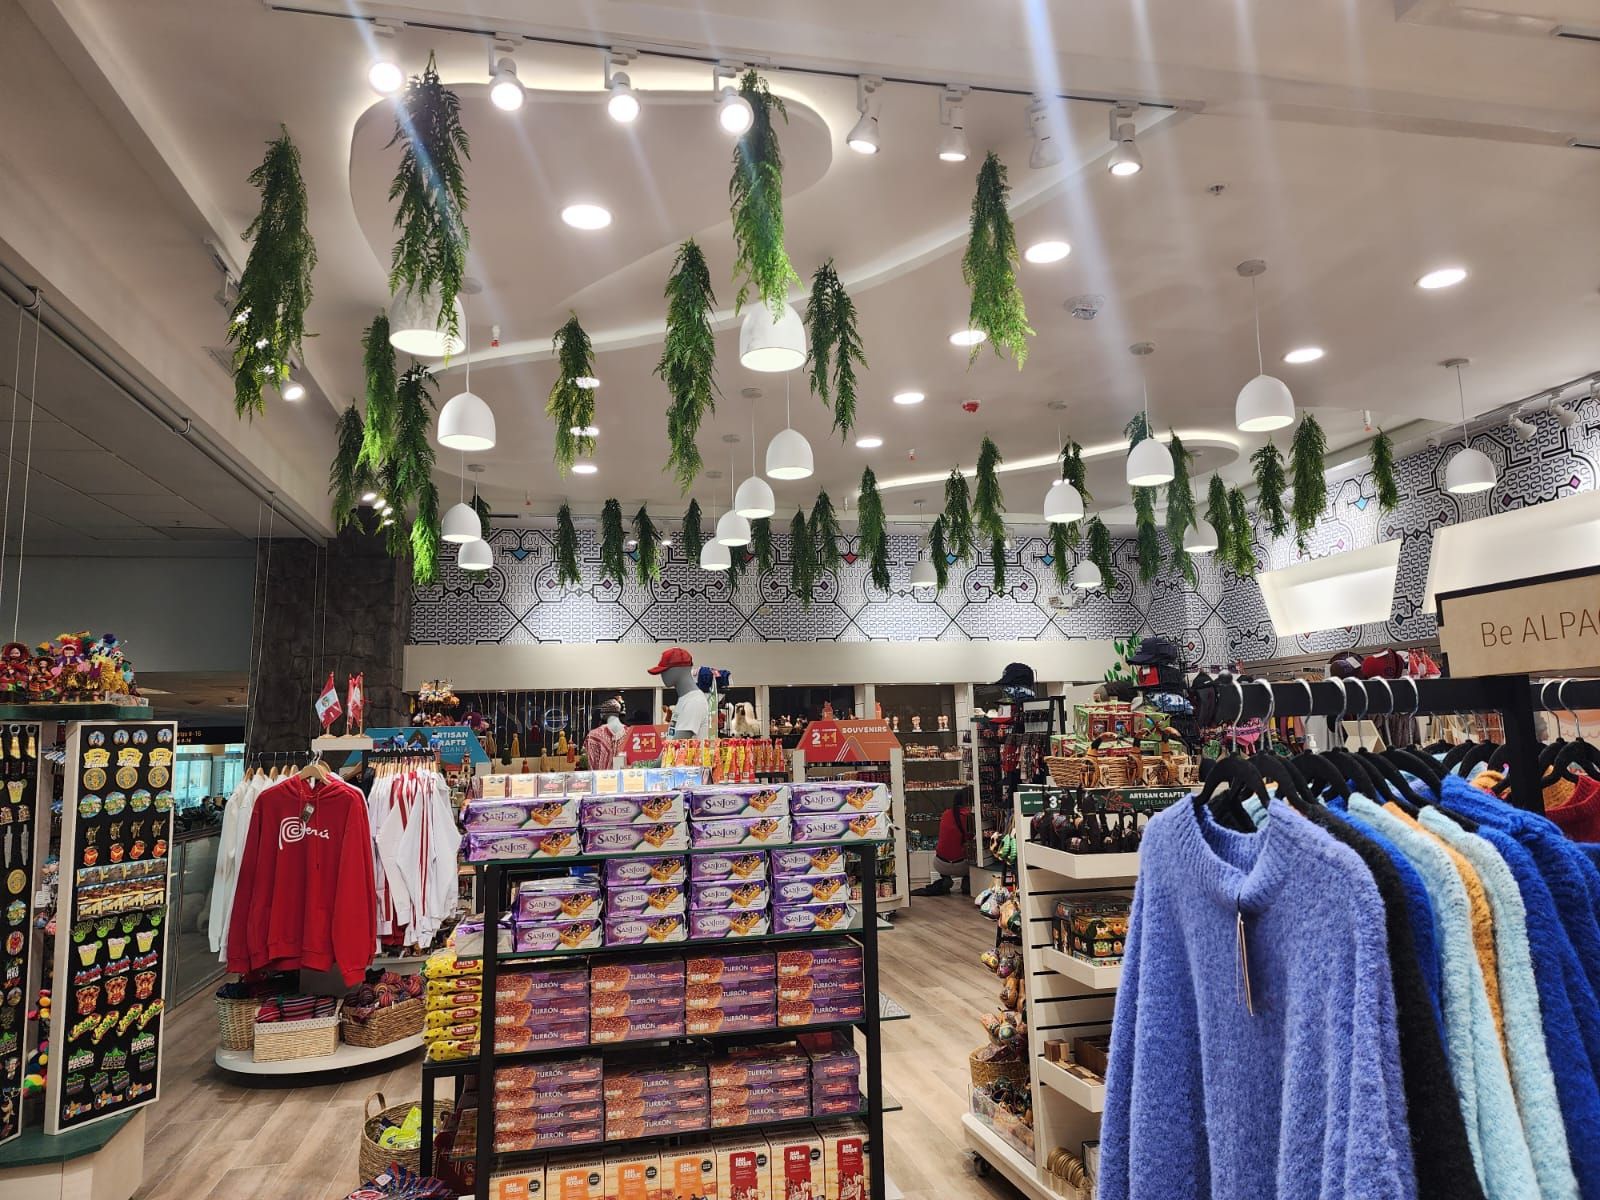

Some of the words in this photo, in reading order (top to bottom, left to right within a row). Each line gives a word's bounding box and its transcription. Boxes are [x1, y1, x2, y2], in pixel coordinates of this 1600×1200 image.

[1480, 621, 1513, 648] Be
[1522, 608, 1600, 644] ALPA
[841, 726, 887, 734] SOUVENIRS
[437, 731, 468, 739] RTISAN
[811, 732, 838, 745] 2+1
[438, 739, 466, 747] RAFTS
[632, 736, 657, 750] 2+1
[1129, 792, 1158, 800] ARTISAN
[1159, 791, 1186, 799] CRAFTS
